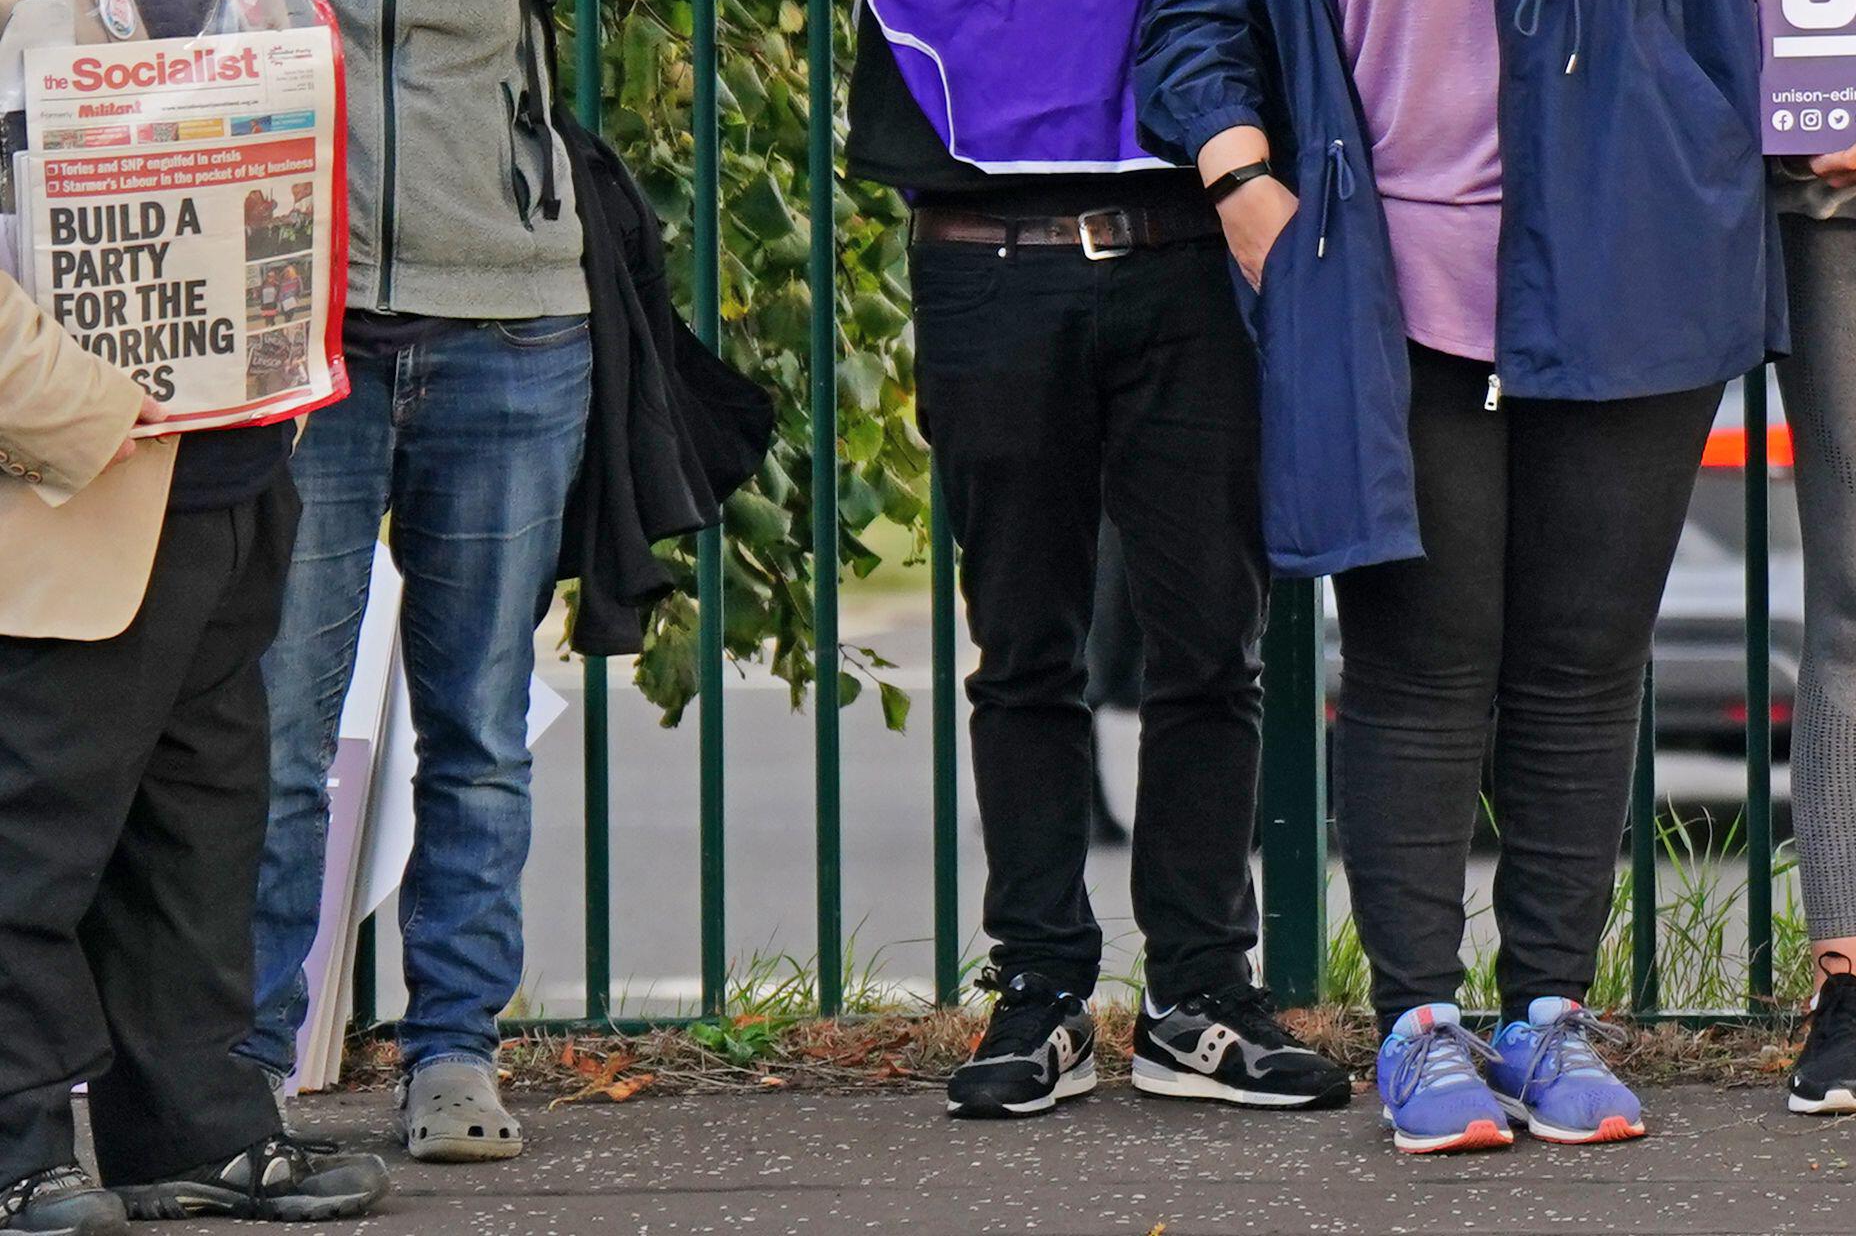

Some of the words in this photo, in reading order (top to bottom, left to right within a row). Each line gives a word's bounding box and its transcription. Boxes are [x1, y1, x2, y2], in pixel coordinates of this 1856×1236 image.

[44, 74, 68, 91] the
[71, 48, 260, 93] Socialist
[80, 102, 142, 118] Militant
[61, 162, 94, 176] Tories
[98, 160, 118, 173] and
[121, 157, 144, 171] SNP
[147, 154, 195, 172] engulfed
[197, 153, 208, 165] in
[211, 150, 241, 163] crisis
[62, 177, 117, 193] Starmer's
[120, 173, 157, 188] Labour
[160, 172, 172, 185] in
[174, 171, 192, 184] the
[195, 168, 232, 184] pocket
[235, 165, 246, 178] of
[248, 162, 265, 178] big
[267, 158, 314, 174] business
[50, 201, 166, 246] BUILD
[175, 197, 202, 236] A
[52, 242, 170, 289] PARTY
[53, 289, 127, 330] FOR
[135, 279, 207, 322] THE
[71, 317, 234, 367] ORKING
